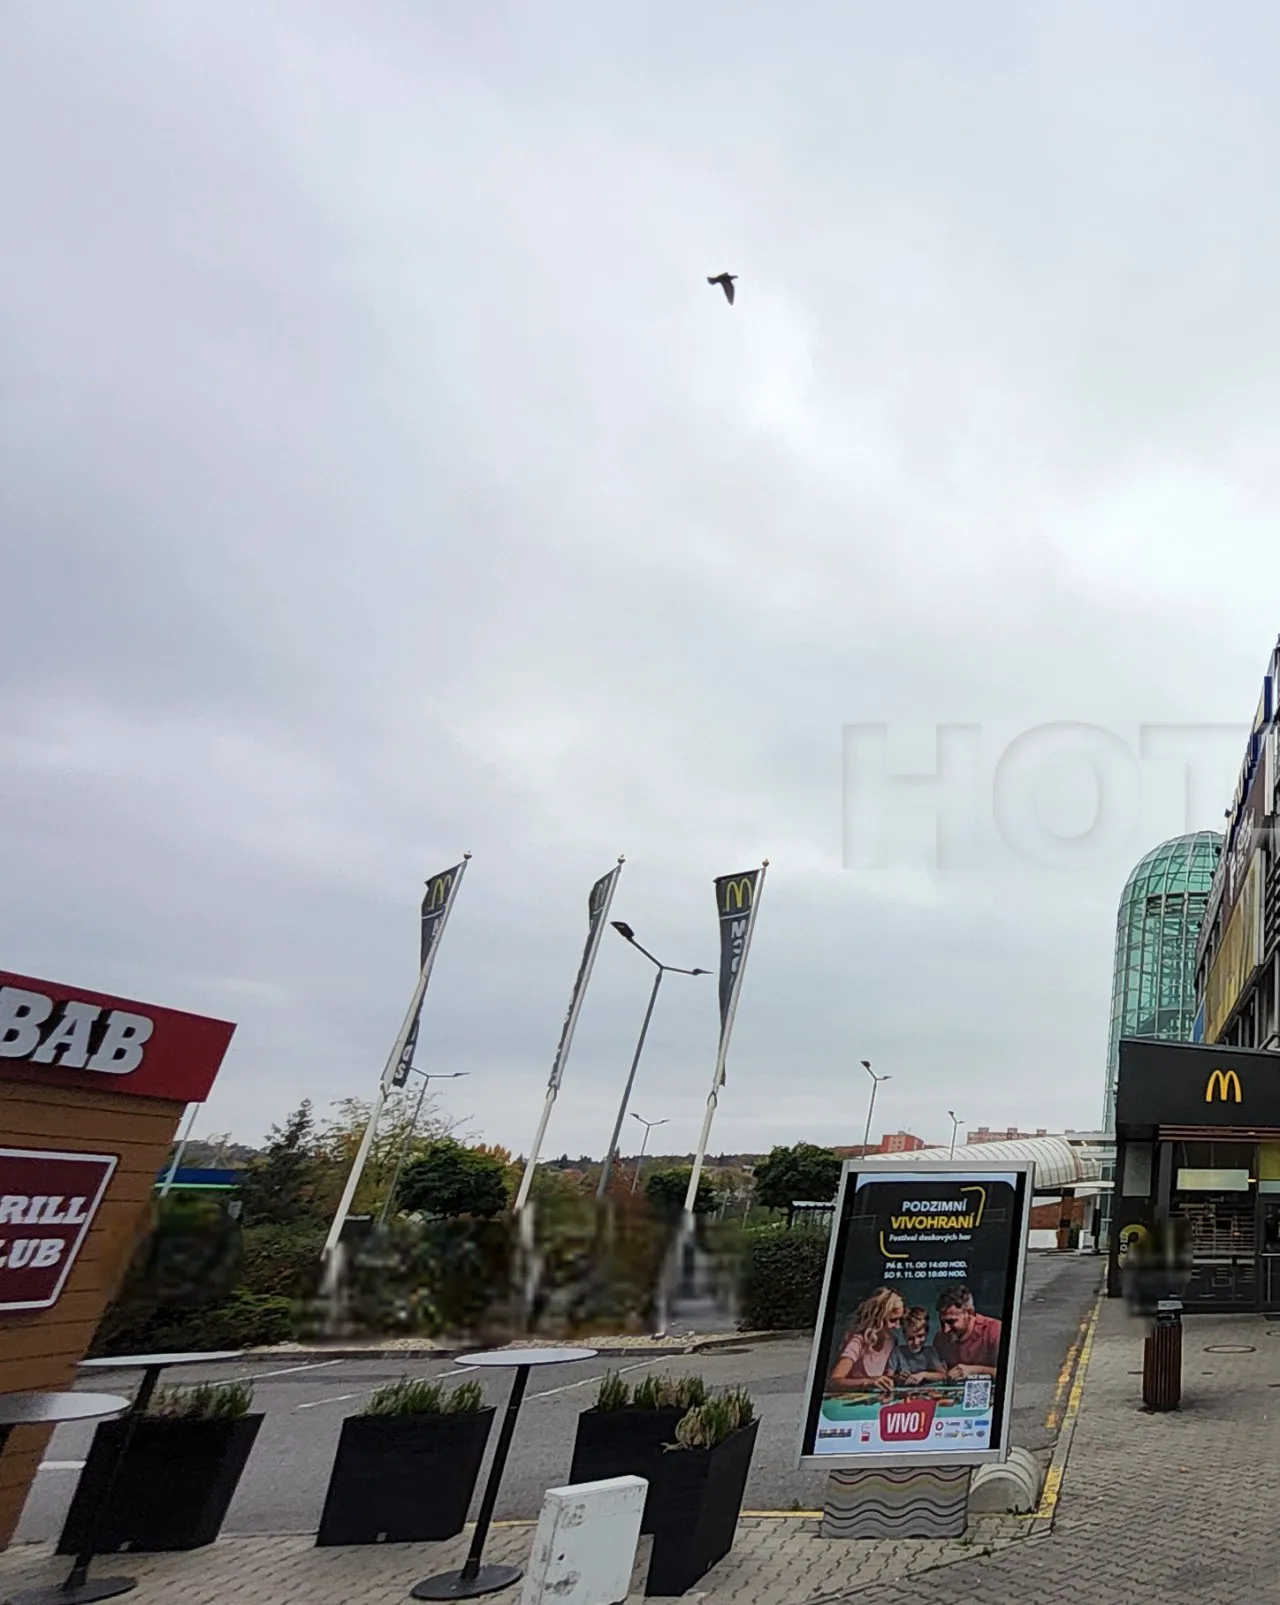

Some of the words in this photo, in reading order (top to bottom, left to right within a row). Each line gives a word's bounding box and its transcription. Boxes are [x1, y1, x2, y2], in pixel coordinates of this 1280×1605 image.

[0, 986, 154, 1074] BAB
[0, 1195, 88, 1224] RILL
[902, 1198, 968, 1212] PODZIMNÍ
[890, 1212, 975, 1230] VIVOHRANÍ
[889, 1233, 918, 1242] Festival
[886, 1412, 926, 1433] VIVO!
